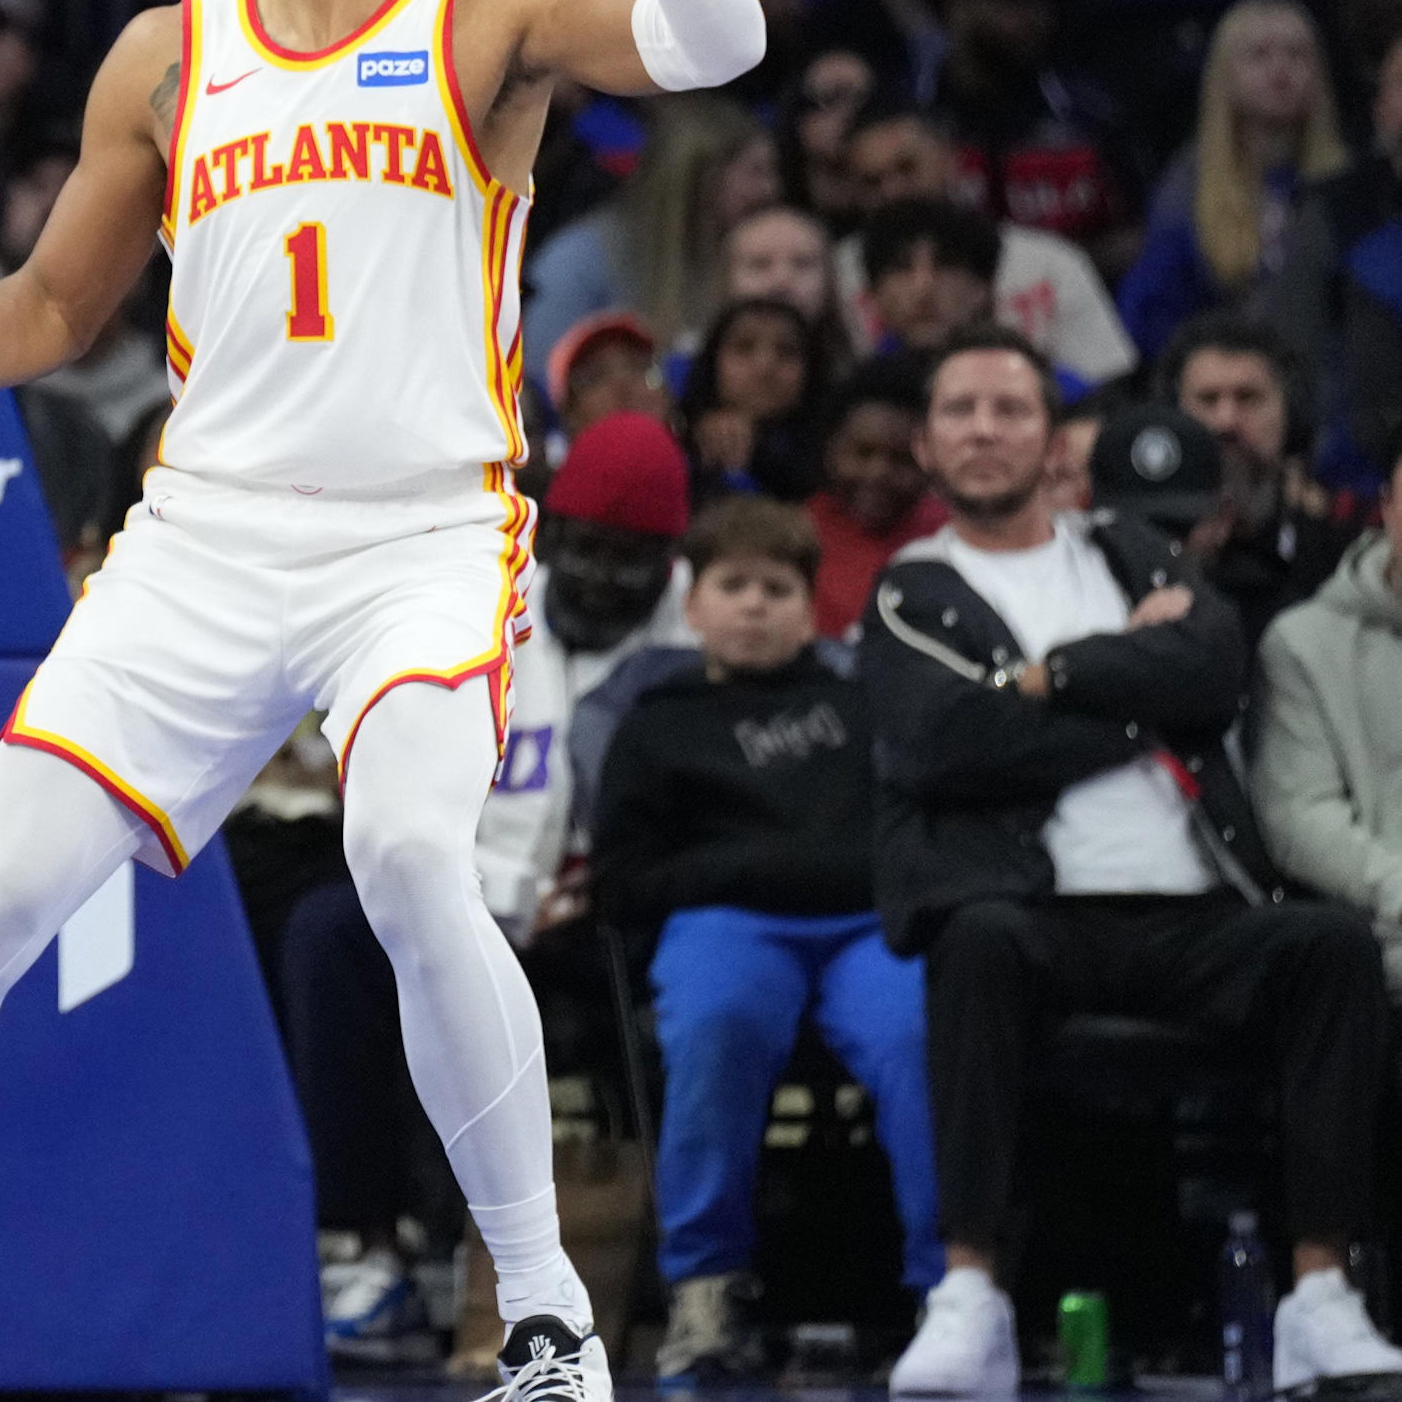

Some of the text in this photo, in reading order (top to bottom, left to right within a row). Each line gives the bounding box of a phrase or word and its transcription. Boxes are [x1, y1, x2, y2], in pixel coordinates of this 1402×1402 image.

[360, 57, 426, 81] paze
[188, 121, 455, 228] ATLANTA
[283, 221, 335, 342] 1
